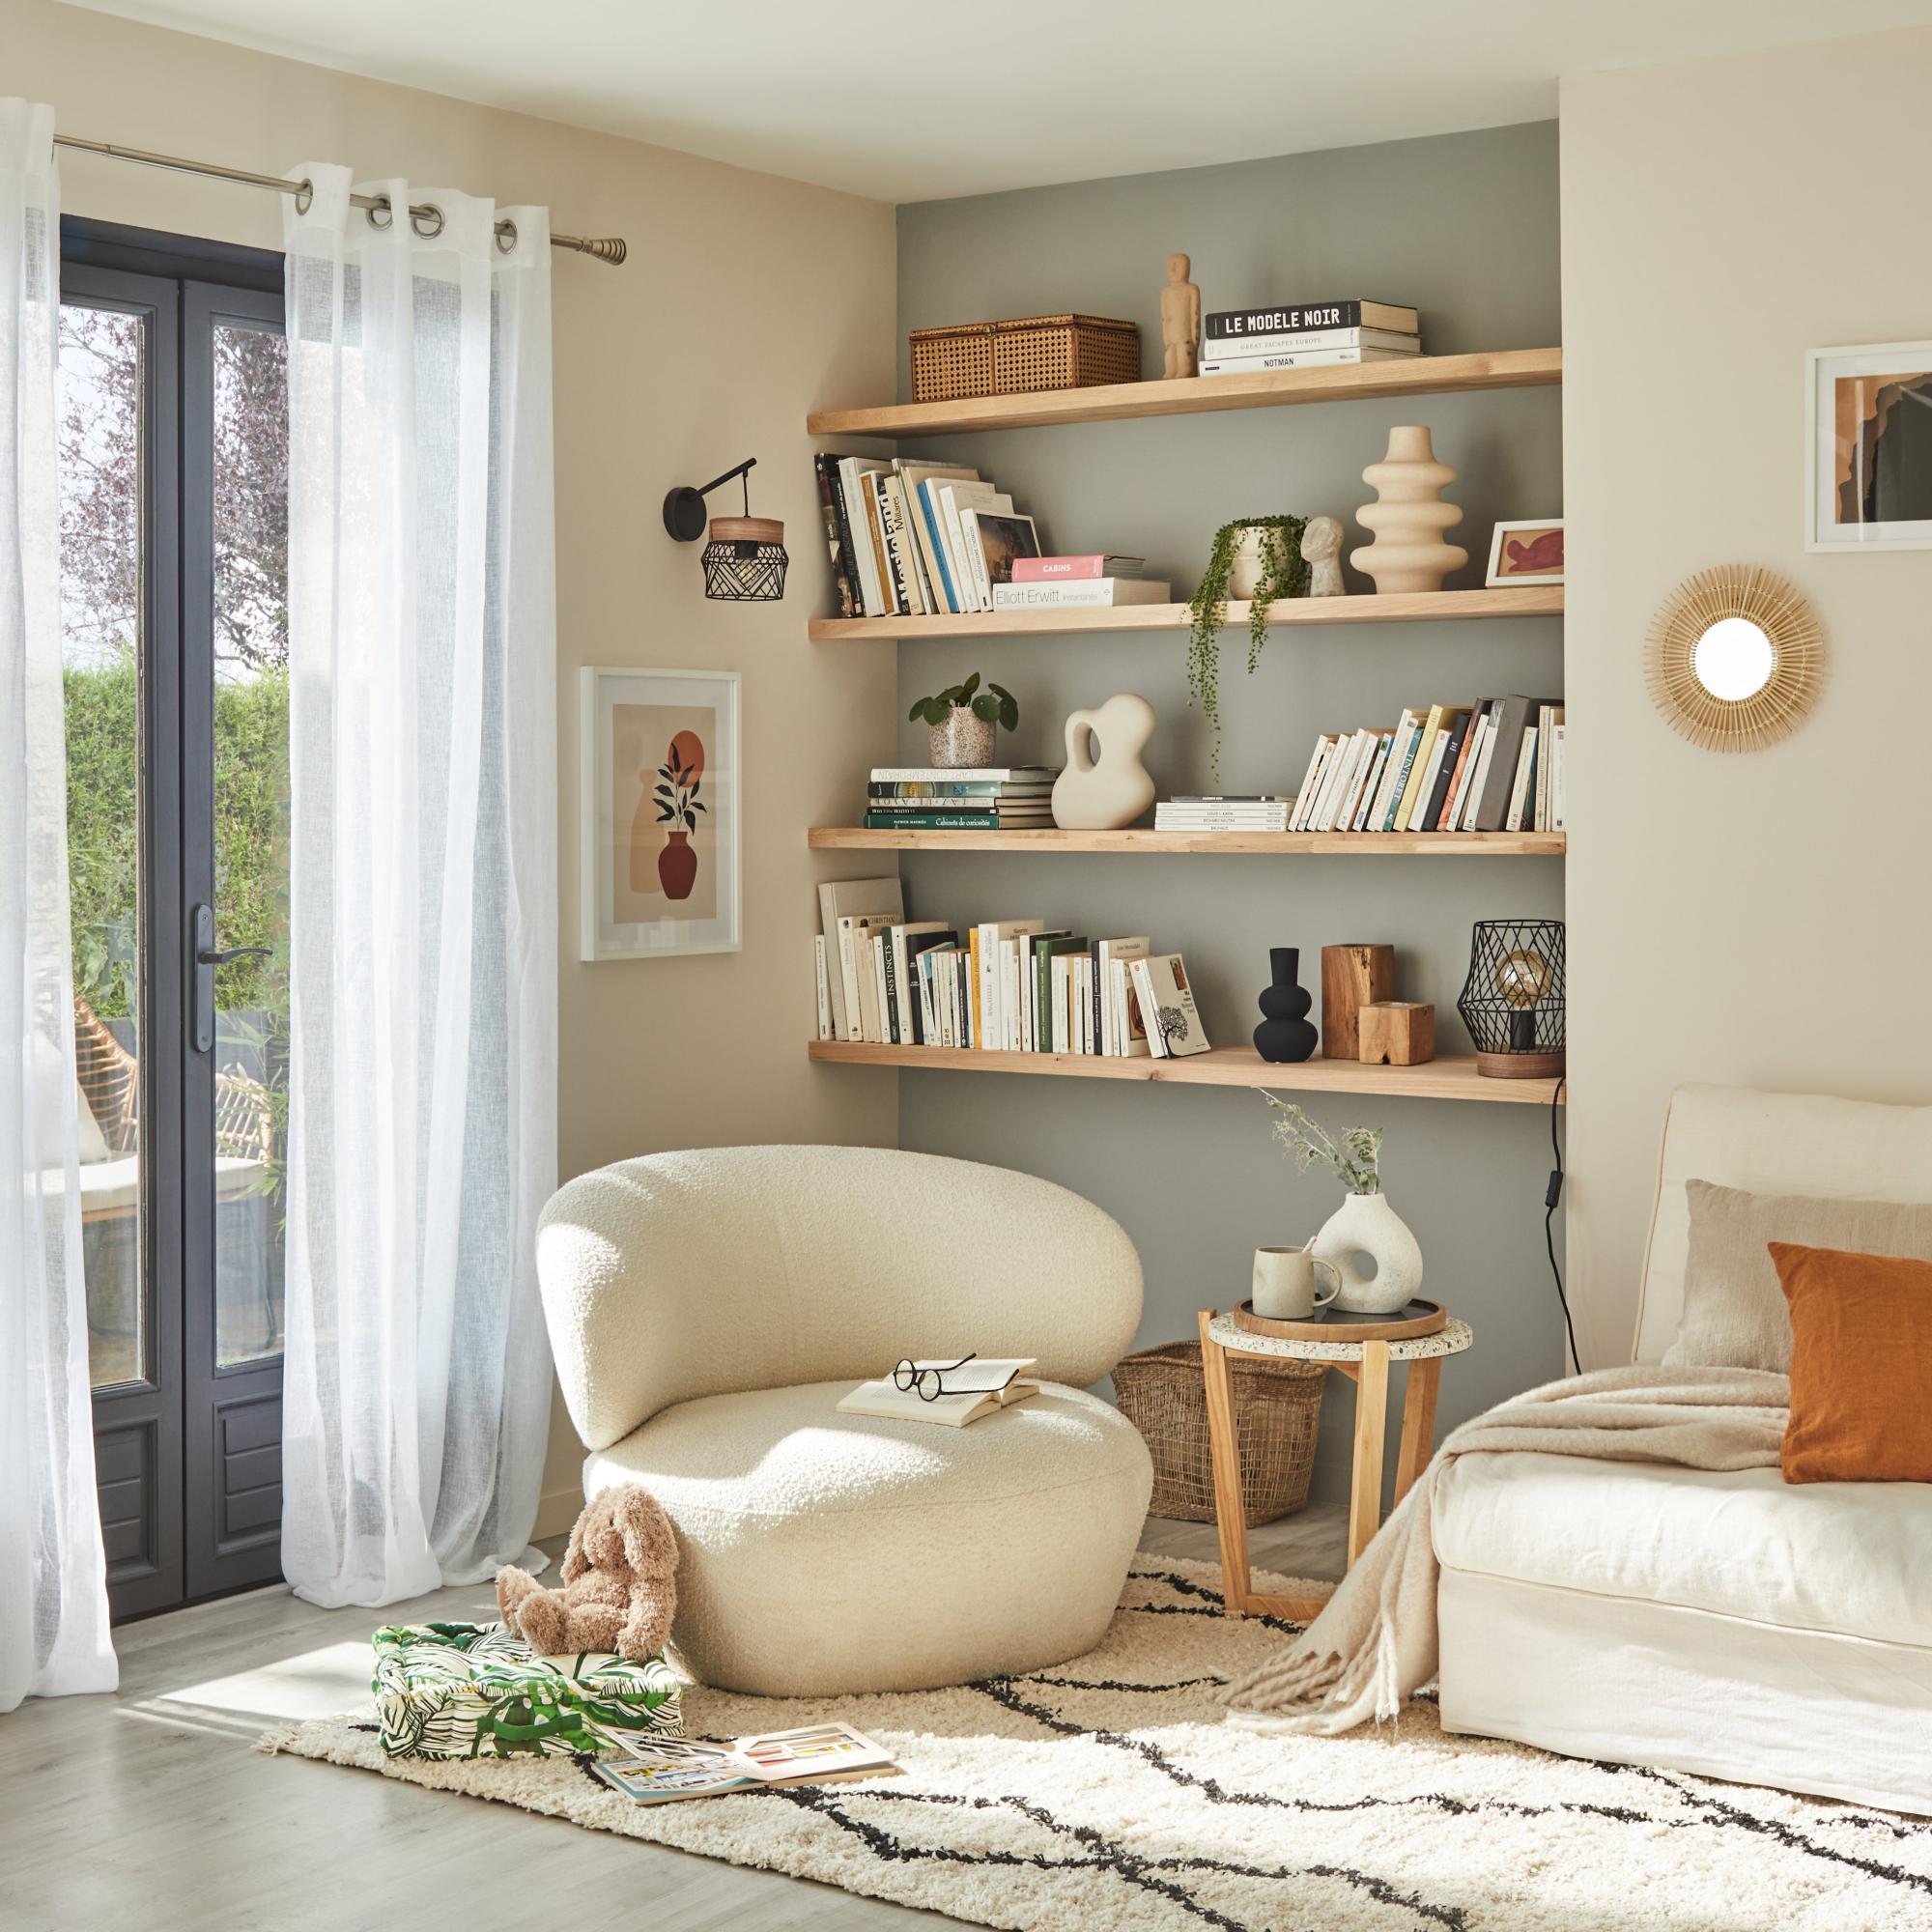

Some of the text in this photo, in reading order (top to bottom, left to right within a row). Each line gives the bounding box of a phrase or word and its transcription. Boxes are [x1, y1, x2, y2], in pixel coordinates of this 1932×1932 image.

[1225, 317, 1243, 334] LE
[1247, 311, 1300, 331] MODÈLE
[1304, 308, 1341, 327] NOIR
[1264, 357, 1294, 368] NOTMAN
[893, 496, 904, 530] Millares
[1042, 564, 1071, 573] CABINS
[996, 590, 1025, 605] Elliott
[1027, 588, 1060, 604] Erwitt
[1393, 753, 1414, 800] TINTORET
[935, 817, 958, 826] Cabinets
[958, 817, 966, 826] de
[884, 944, 895, 996] INSTINCTS
